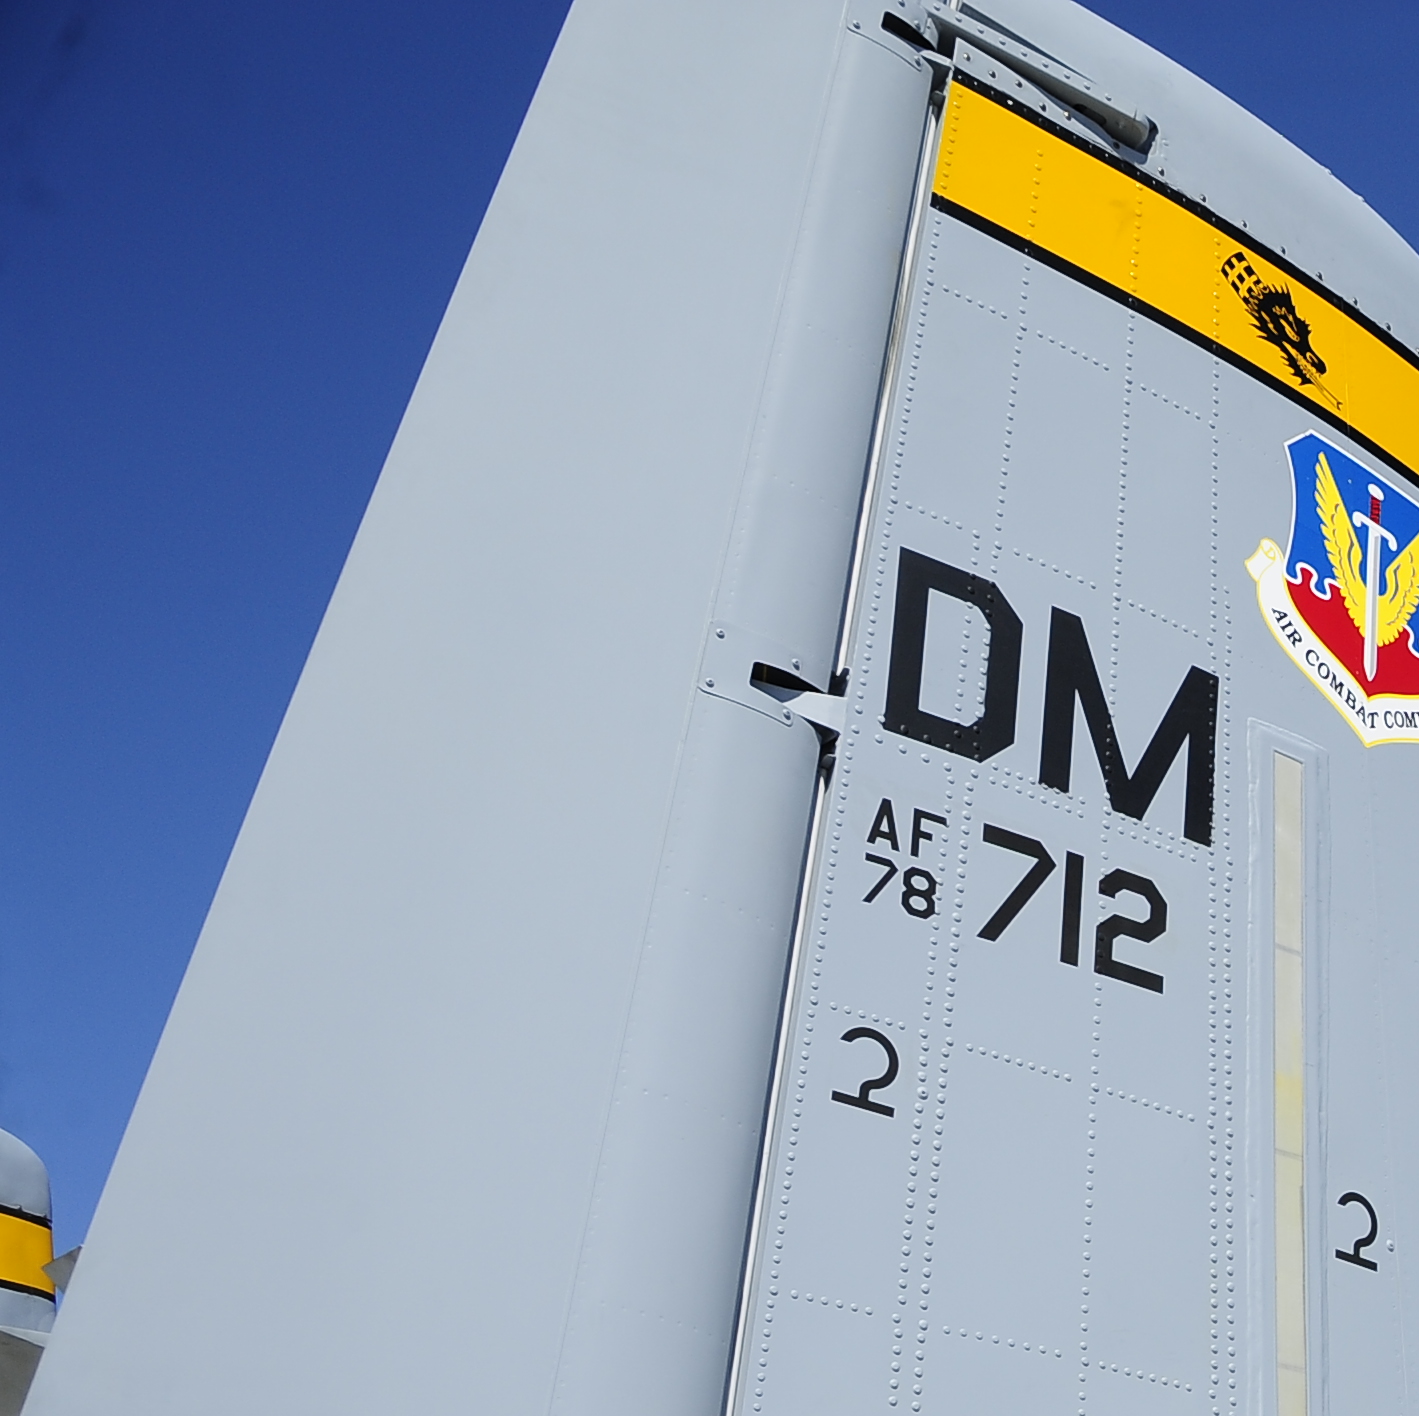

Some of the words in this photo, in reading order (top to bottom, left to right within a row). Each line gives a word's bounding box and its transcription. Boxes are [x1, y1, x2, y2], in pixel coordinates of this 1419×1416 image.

[882, 546, 1220, 847] DM
[1271, 607, 1303, 648] AIR
[1304, 649, 1379, 729] COMBAT
[866, 797, 948, 858] AF
[862, 852, 937, 920] 78
[976, 822, 1168, 994] 712
[831, 1026, 900, 1118] 2
[1335, 1191, 1378, 1272] 2
